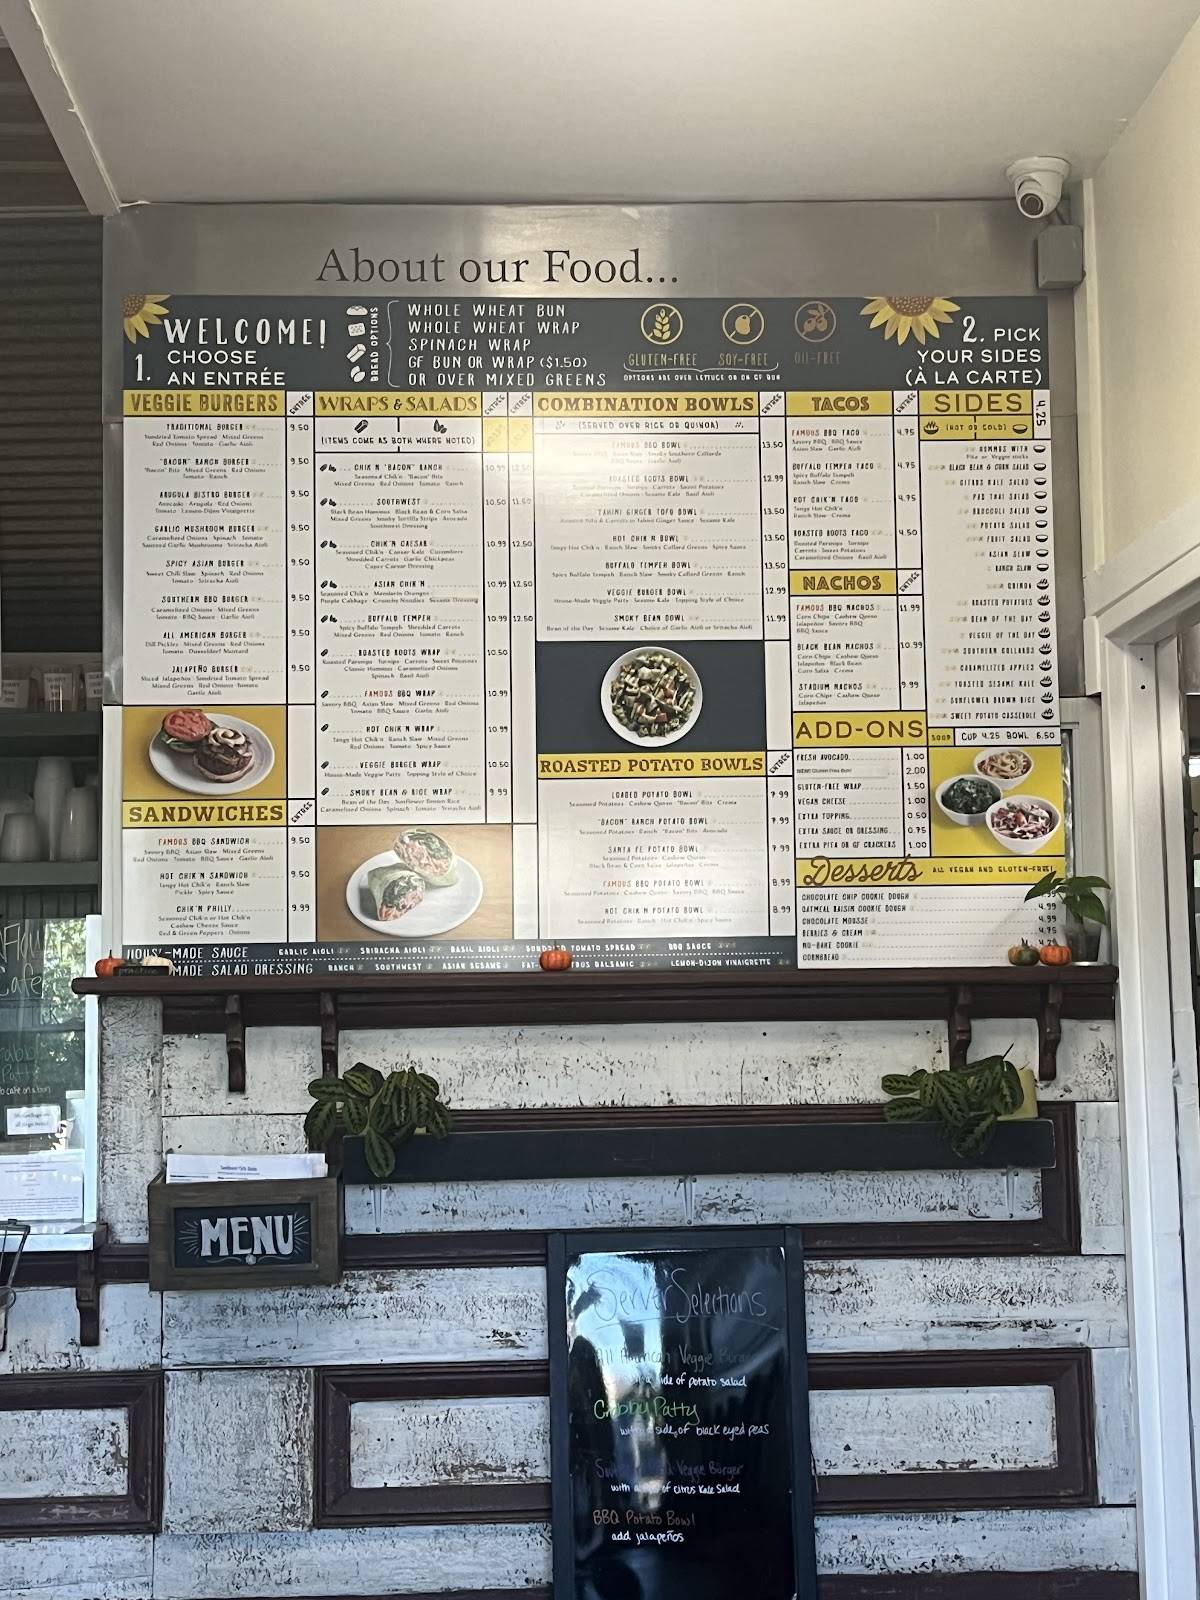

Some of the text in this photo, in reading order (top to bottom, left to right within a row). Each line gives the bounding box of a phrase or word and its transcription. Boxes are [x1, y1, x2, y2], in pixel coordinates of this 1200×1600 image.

[316, 248, 678, 283] About our Food...
[408, 304, 565, 317] WHOLE WHEAT BUN
[163, 318, 327, 349] WELCOME!
[408, 321, 580, 334] WHOLE WHEAT WRAP
[962, 316, 1041, 342] 2. PICK
[370, 307, 379, 382] BREAD OPTIONS
[409, 338, 531, 351] SPINACH WRAP
[167, 350, 257, 364] CHOOSE
[409, 356, 587, 368] GF BUN OR WRAP ($1.50)
[628, 353, 697, 366] GLUTEN-FREE
[718, 353, 768, 366] SOY-FREE
[917, 350, 1041, 363] YOUR SIDES
[135, 354, 151, 382] 1.
[167, 367, 286, 385] AN ENTRÉE
[409, 373, 606, 386] OR OVER MIXED GREENS
[935, 371, 960, 385] LA
[967, 370, 1042, 386] CARTE)
[131, 394, 278, 412] VEGGIE BURGERS
[319, 396, 388, 411] WRAPS
[405, 396, 477, 411] SALADS
[538, 397, 754, 412] COMBINATION BOWLS
[812, 397, 870, 411] TACOS
[934, 393, 1022, 412] SIDES
[1036, 400, 1046, 426] 4.25
[803, 576, 882, 590] NACHOS
[796, 720, 923, 739] ADD-ONS
[961, 732, 977, 740] CUP
[540, 757, 763, 773] ROASTED POTATO BOWLS
[129, 805, 283, 822] SANDWICHES
[803, 854, 923, 887] Desserts
[128, 947, 248, 959] HOUS-MADE SAUCE
[211, 964, 248, 976] SALAD
[254, 963, 313, 976] DRESSING
[200, 1215, 294, 1257] MENU
[676, 1372, 748, 1388] of potato salad
[594, 1396, 700, 1425] Crbby Patty
[748, 1424, 770, 1437] peas
[593, 1509, 620, 1525] BBQ
[612, 1531, 631, 1541] add
